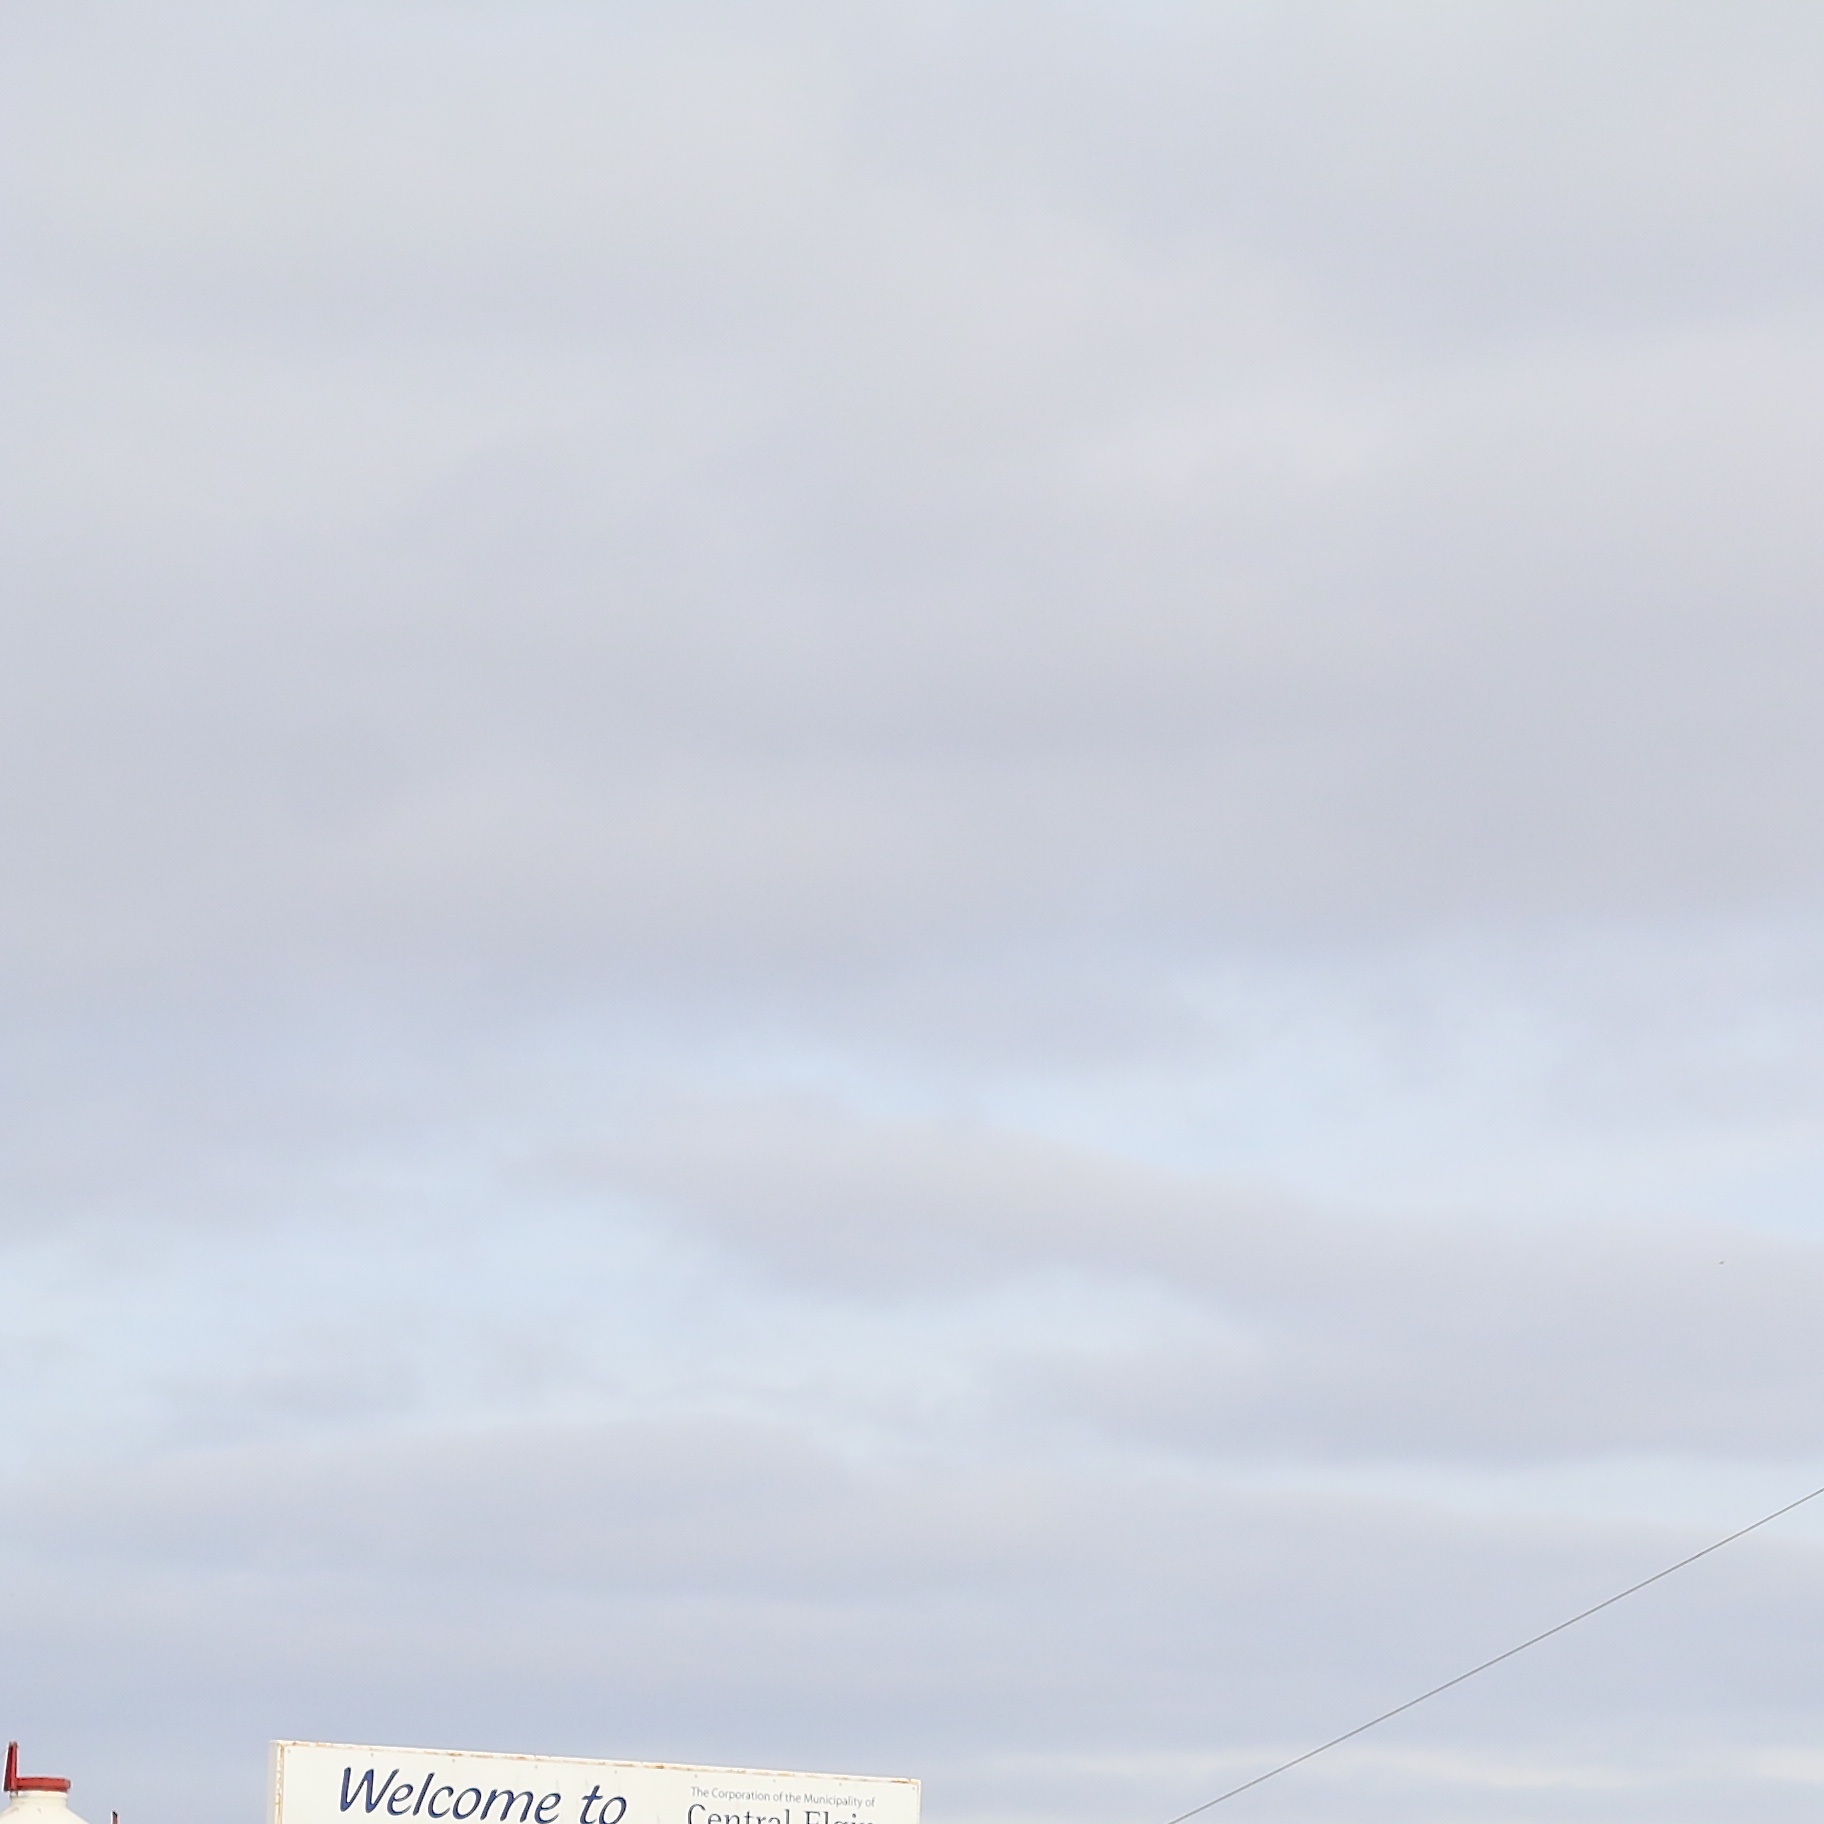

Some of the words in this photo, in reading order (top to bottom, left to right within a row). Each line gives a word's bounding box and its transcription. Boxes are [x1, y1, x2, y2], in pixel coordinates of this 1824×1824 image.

[691, 1786, 710, 1798] The
[711, 1788, 770, 1802] Corporation
[773, 1791, 784, 1803] of
[785, 1792, 801, 1804] the
[803, 1794, 863, 1808] Municipality
[865, 1797, 876, 1808] of
